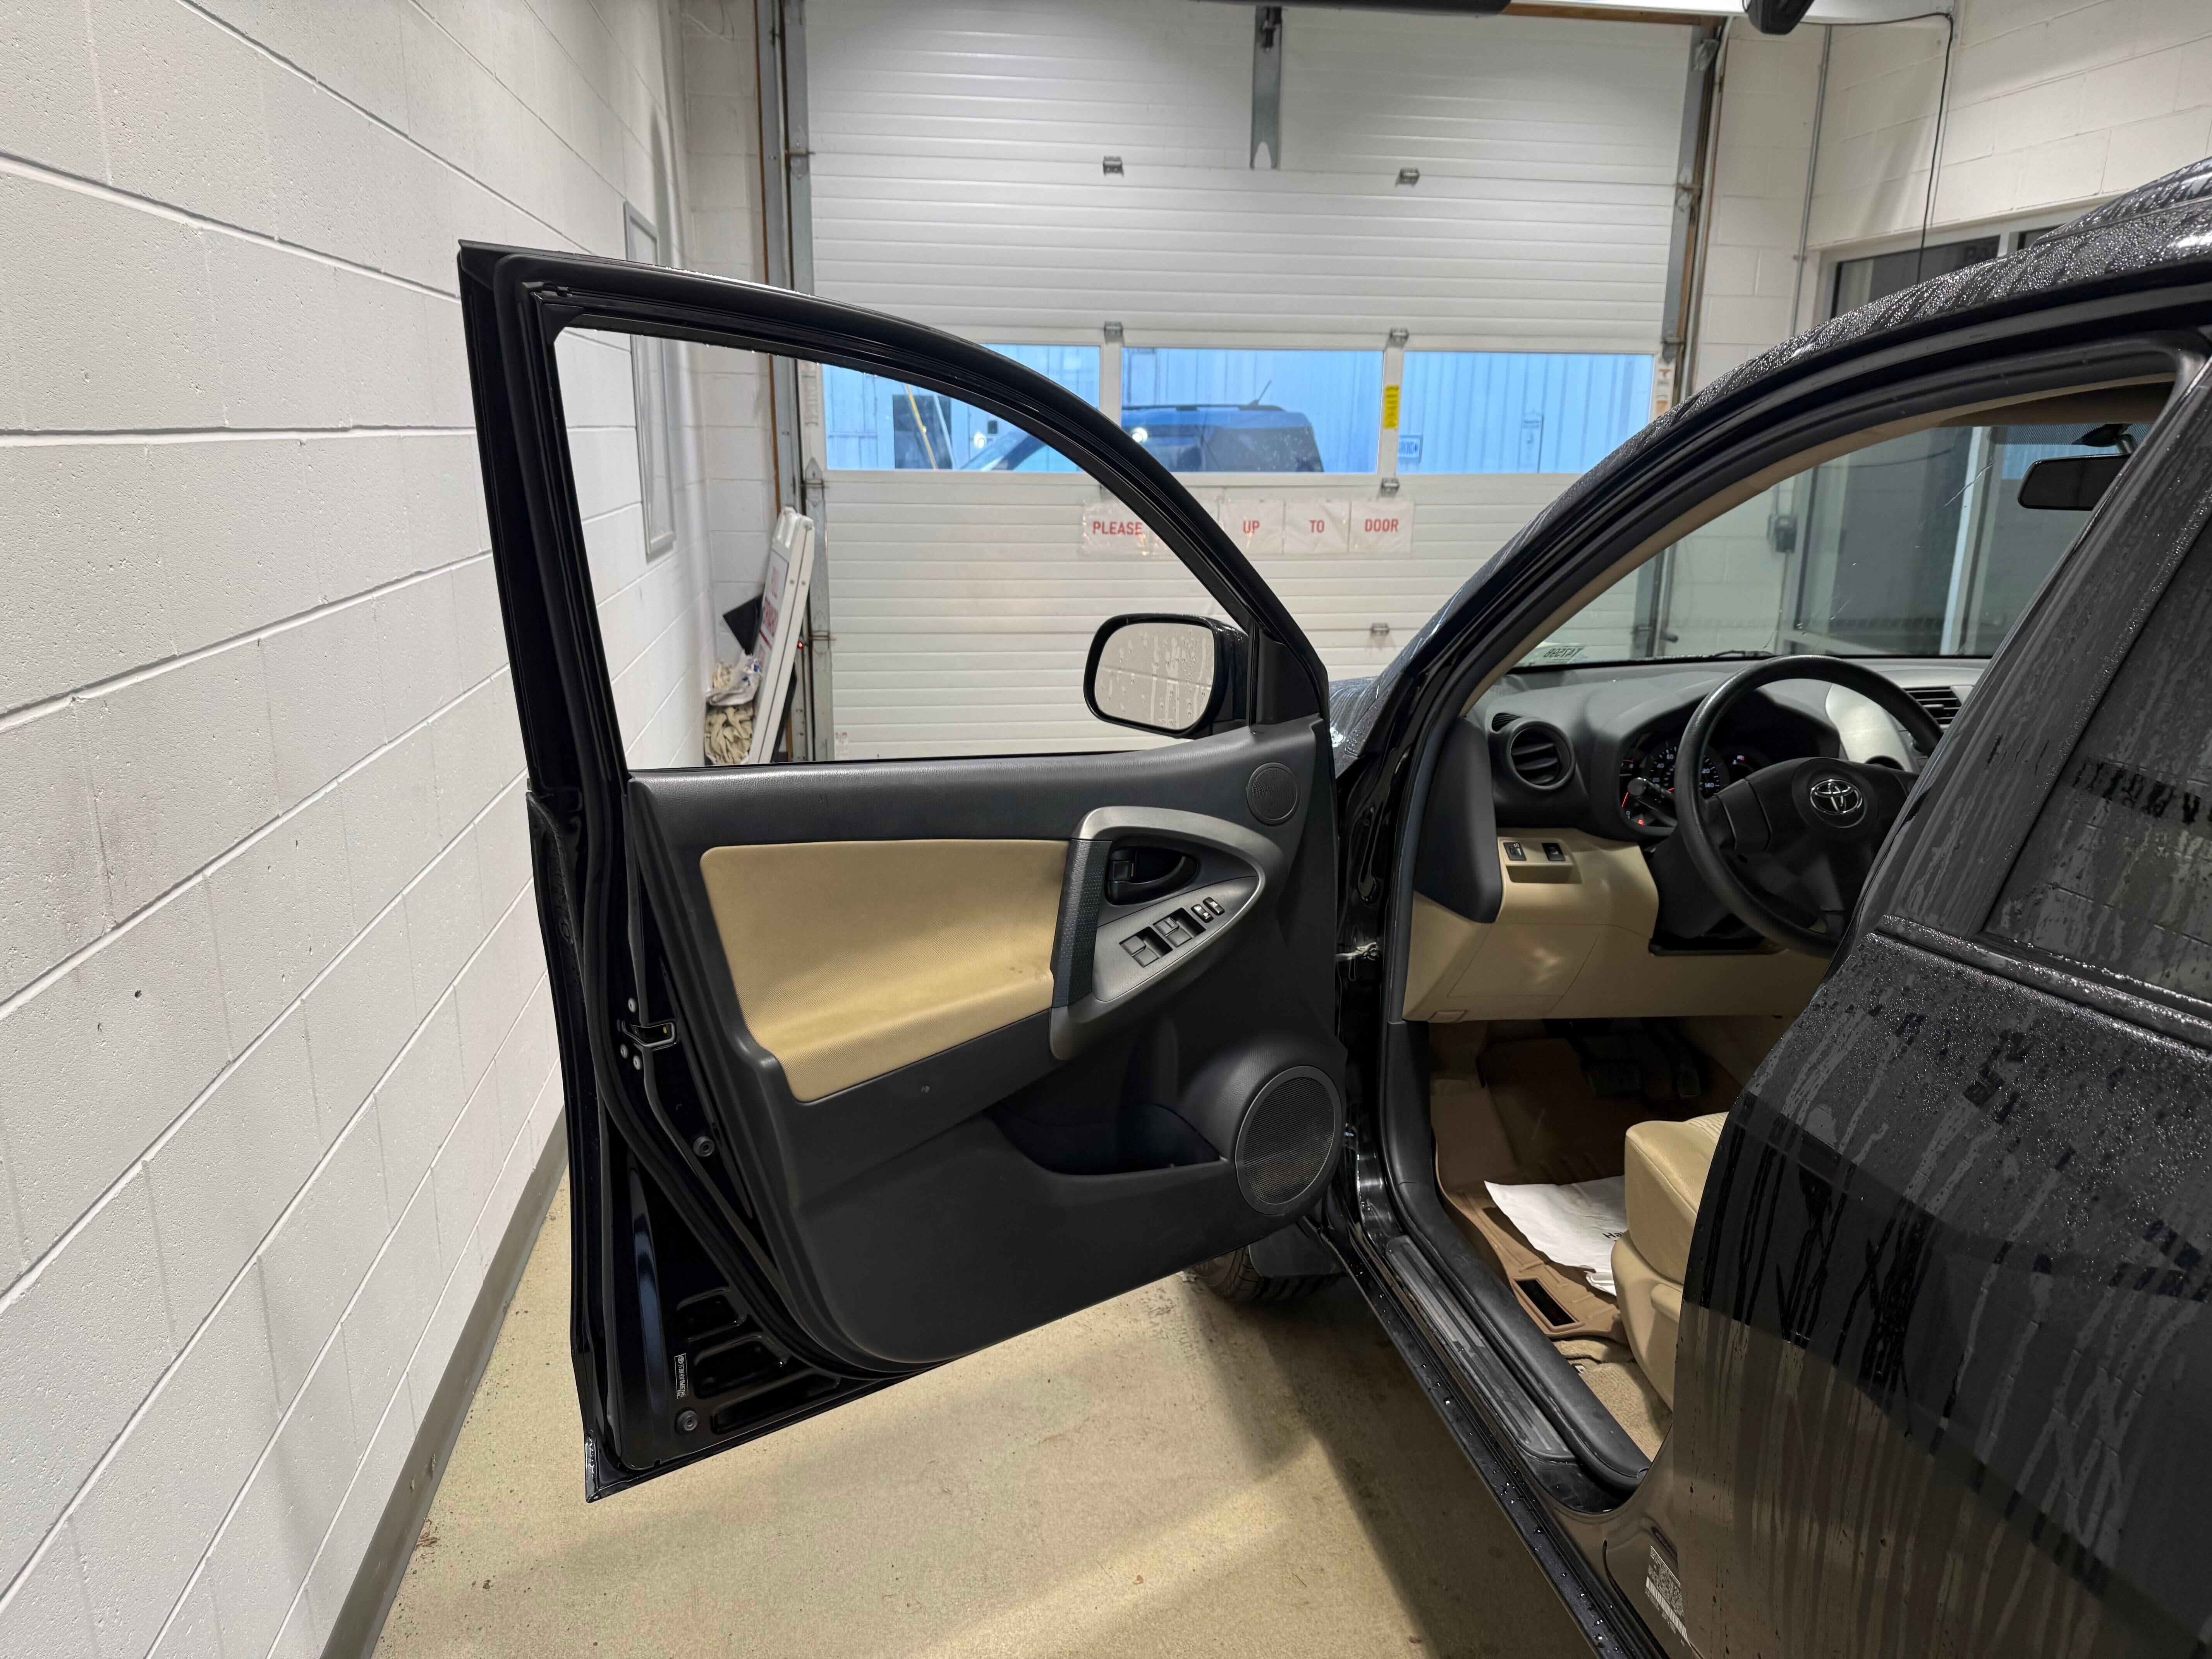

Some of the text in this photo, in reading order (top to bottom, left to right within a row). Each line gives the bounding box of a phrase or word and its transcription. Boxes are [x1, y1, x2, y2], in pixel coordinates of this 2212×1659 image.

[1092, 519, 1399, 535] PLEASE UP TO DOOR
